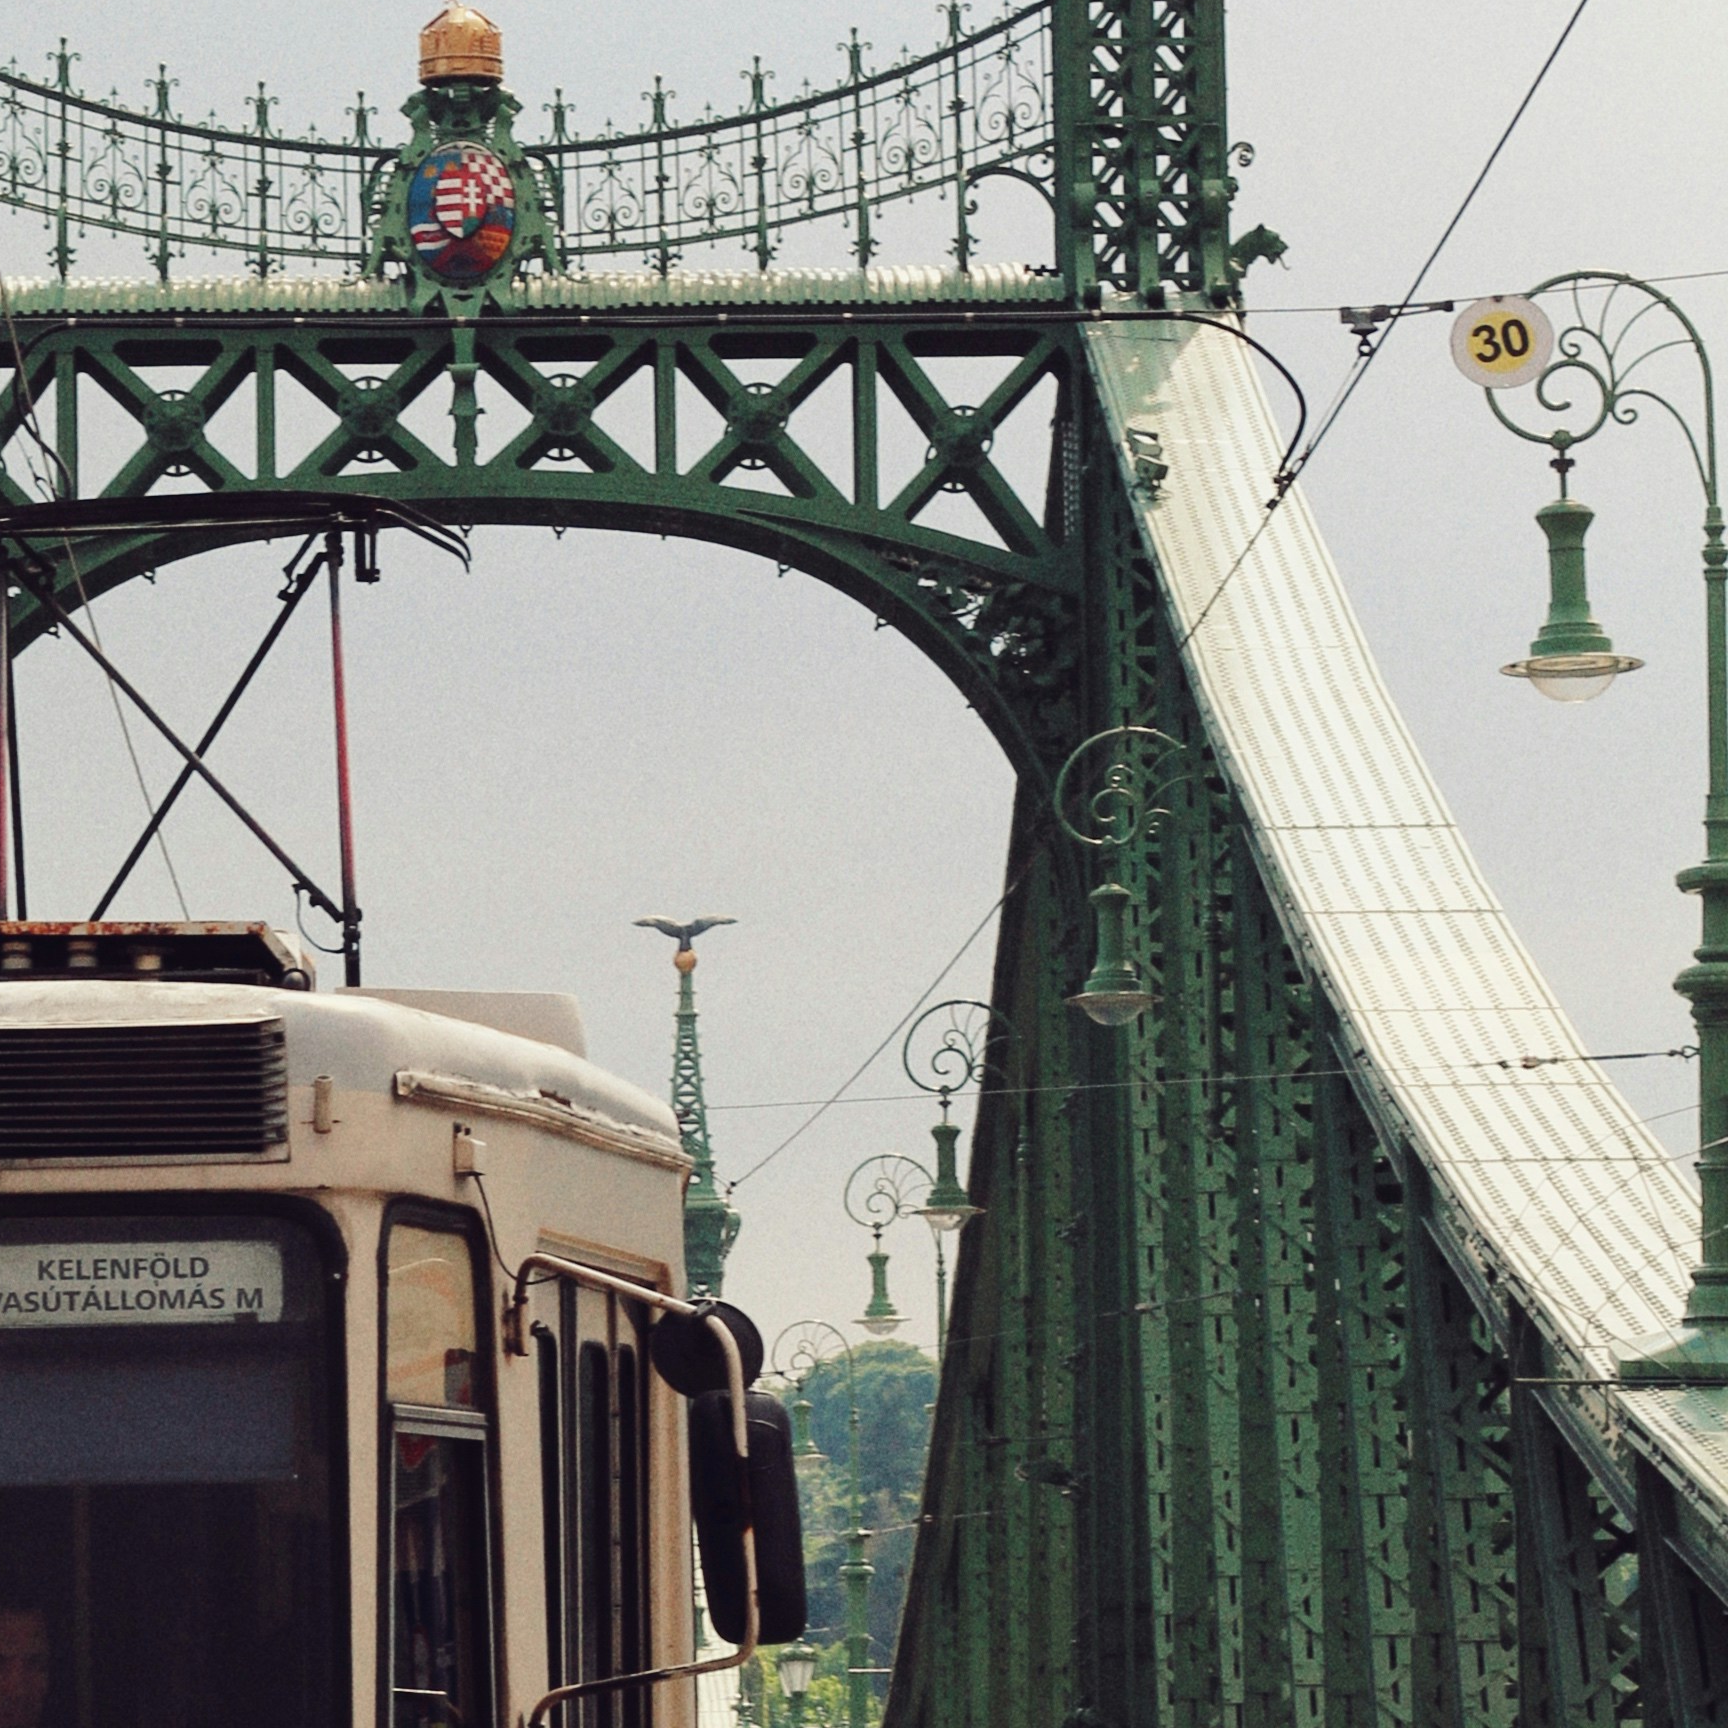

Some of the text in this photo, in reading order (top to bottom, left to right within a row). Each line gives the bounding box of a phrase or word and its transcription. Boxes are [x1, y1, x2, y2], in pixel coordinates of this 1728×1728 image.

[1472, 319, 1529, 363] 30
[37, 1252, 210, 1281] KELENFÖLD
[236, 1287, 264, 1310] M
